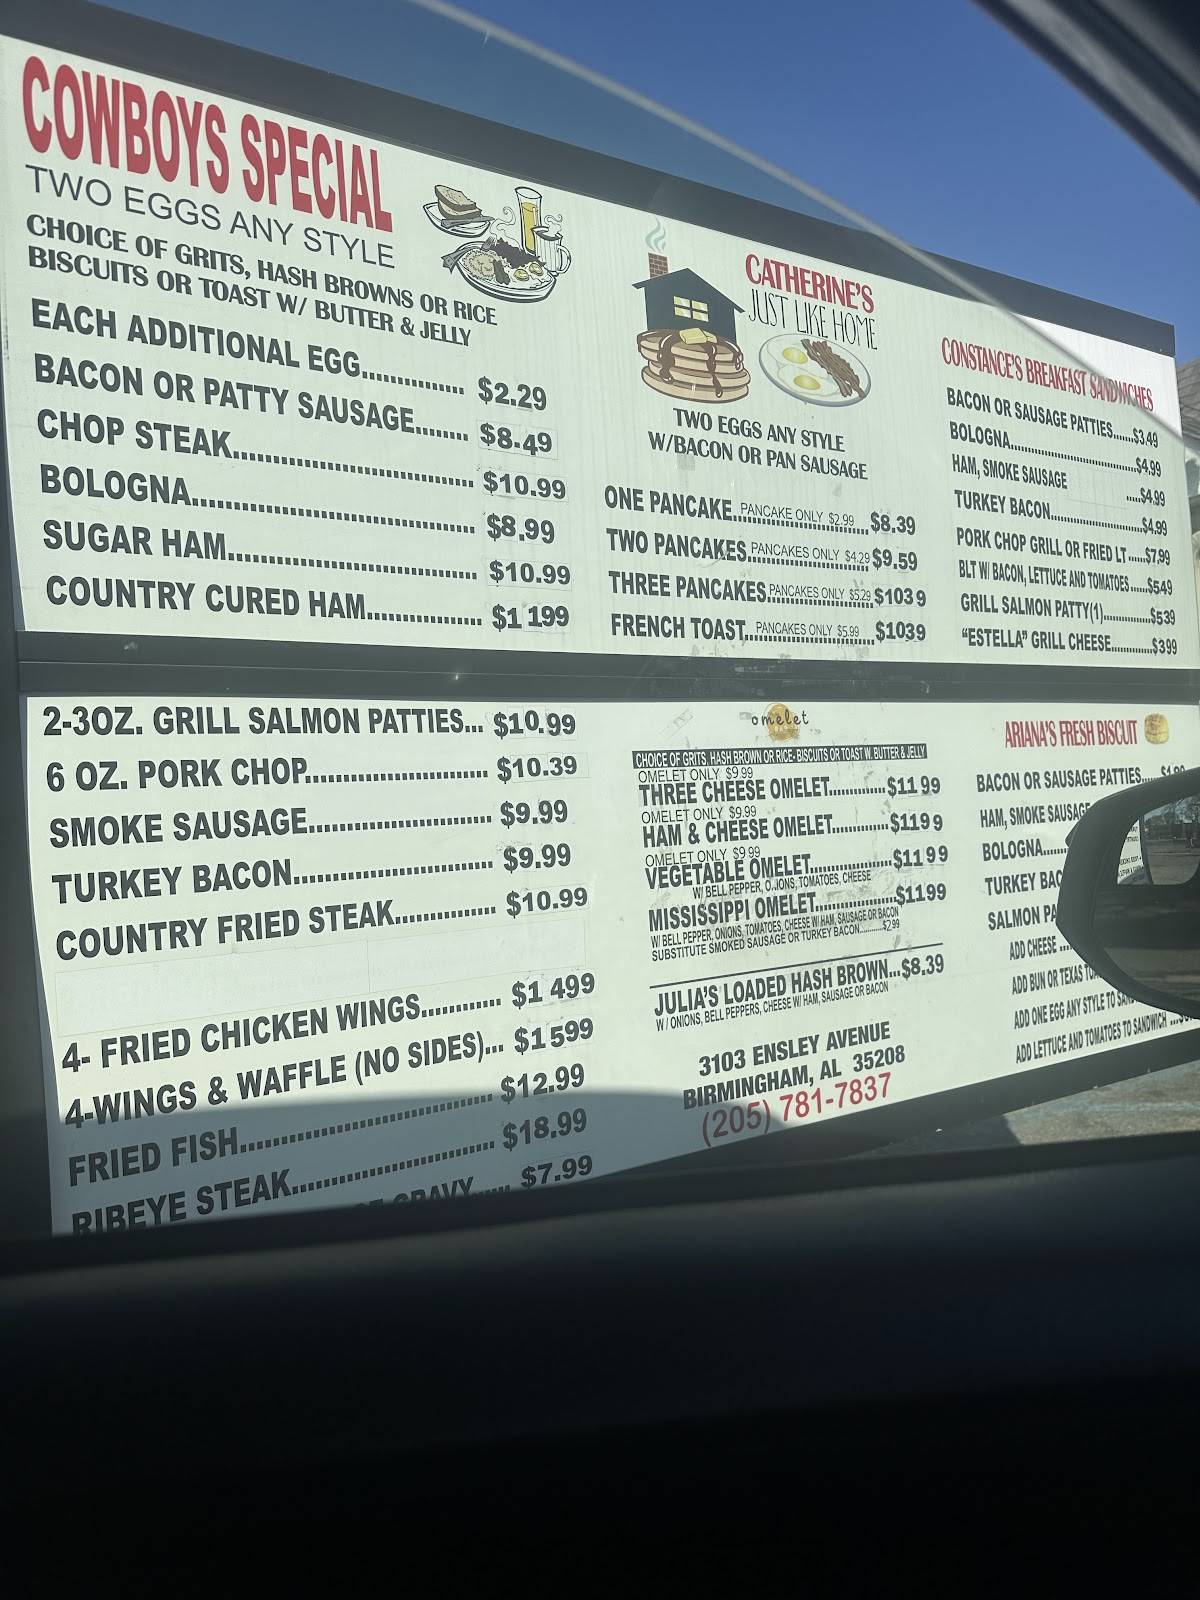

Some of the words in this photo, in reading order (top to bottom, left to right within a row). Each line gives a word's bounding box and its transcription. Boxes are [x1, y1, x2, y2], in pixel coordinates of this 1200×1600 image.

[22, 56, 230, 194] COWBOYS
[241, 113, 392, 232] SPECIAL
[26, 164, 112, 207] TWO
[124, 186, 221, 231] EGGS
[230, 211, 294, 246] ANY
[304, 227, 394, 268] STYLE
[27, 214, 128, 252] CHOICE
[136, 235, 168, 260] OF
[175, 245, 251, 279] GRITS,
[258, 260, 317, 289] HASH
[325, 273, 413, 308] BROWNS
[420, 293, 448, 316] OR
[454, 302, 497, 326] RICE
[29, 246, 149, 287] BISCUITS
[157, 270, 191, 296] OR
[198, 278, 270, 309] TOAST
[277, 292, 307, 316] W/
[316, 299, 394, 332] BUTTER
[400, 317, 415, 336] &
[420, 321, 471, 347] JELLY
[749, 289, 788, 328] JUST
[795, 300, 828, 338] LIKE
[833, 308, 877, 350] HOME
[31, 298, 117, 339] EACH
[128, 314, 300, 368] ADDITIONAL
[478, 376, 547, 410] $2.29
[34, 353, 143, 396] BACON
[154, 371, 195, 403] OR
[204, 377, 289, 414] PATTY
[1026, 358, 1087, 395] BREAKFAST
[1090, 374, 1153, 411] SANDWICHES
[947, 387, 990, 413] BACON
[995, 398, 1012, 418] OR
[1015, 404, 1067, 429] SAUSAGE
[673, 408, 712, 431] TWO
[718, 416, 762, 439] EGGS
[767, 424, 796, 445] ANY
[801, 430, 845, 452] STYLE
[38, 409, 124, 445] CHOP
[483, 471, 566, 499] $10.99
[739, 445, 761, 465] OR
[767, 450, 796, 470] PAN
[801, 455, 868, 480] SAUSAGE
[952, 454, 980, 479] HAM,
[983, 459, 1019, 481] SMOKE
[1022, 467, 1067, 489] SAUSAGE
[604, 485, 643, 512] ONE
[741, 503, 793, 520] PANCAKE
[796, 509, 823, 522] ONLY
[954, 490, 1005, 514] TURKEY
[487, 513, 554, 544] $8.99
[606, 528, 648, 553] TWO
[751, 542, 810, 559] PANCAKES
[813, 548, 839, 561] ONLY
[957, 527, 991, 548] PORK
[995, 532, 1026, 552] CHOP
[1030, 537, 1062, 556] GRILL
[1066, 540, 1080, 558] OR
[1083, 543, 1112, 562] FRIED
[44, 519, 153, 555] SUGAR
[489, 560, 571, 585] $10.99
[609, 571, 670, 596] THREE
[769, 584, 819, 598] PANCAKES
[822, 588, 844, 600] ONLY
[959, 560, 976, 579] BLT
[1029, 566, 1066, 587] LETTUCE
[1069, 571, 1085, 588] AND
[1088, 573, 1129, 592] TOMATOES
[46, 575, 195, 610] COUNTRY
[206, 584, 299, 616] CURED
[961, 593, 998, 613] GRILL
[1002, 596, 1051, 616] SALMON
[611, 614, 685, 638] FRENCH
[756, 621, 806, 635] PANCAKES
[810, 625, 832, 636] ONLY
[1032, 631, 1065, 650] GRILL
[153, 706, 240, 735] GRILL
[249, 706, 359, 734] SALMON
[751, 710, 809, 726] omelet
[1059, 720, 1094, 746] FRESH
[1097, 720, 1137, 745] BISCUIT
[636, 752, 668, 767] CHOICE
[734, 750, 760, 764] BROWN
[764, 750, 774, 763] OR
[797, 748, 828, 761] BISCUITS
[46, 762, 64, 792] 6
[138, 759, 222, 788] PORK
[638, 769, 686, 783] OMELET
[690, 768, 720, 780] ONLY
[639, 782, 697, 806] THREE
[702, 779, 765, 803] CHEESE
[977, 772, 1020, 792] BACON
[1024, 771, 1041, 789] OR
[1045, 769, 1096, 788] SAUSAGE
[50, 814, 163, 848] SMOKE
[641, 810, 690, 823] OMELET
[693, 808, 723, 821] ONLY
[1010, 806, 1045, 826] SMOKE
[643, 824, 682, 848] HAM
[688, 823, 700, 844] &
[705, 818, 768, 842] CHEESE
[52, 866, 182, 904] TURKEY
[503, 843, 571, 874] $9.99
[645, 859, 744, 890] VEGETABLE
[985, 873, 1036, 896] TURKEY
[706, 885, 727, 898] BELL
[56, 918, 207, 961] COUNTRY
[217, 909, 300, 944] FRIED
[506, 887, 588, 919] $10.99
[649, 898, 750, 931] MISSISSIPPI
[988, 907, 1040, 930] SALMON
[652, 944, 706, 961] SUBSTITUTE
[709, 940, 744, 953] SMOKED
[748, 934, 786, 948] SAUSAGE
[1010, 941, 1025, 960] ADD
[1027, 936, 1057, 957] CHEESE
[724, 975, 787, 1005] LOADED
[791, 967, 833, 993] HASH
[1012, 976, 1027, 995] ADD
[1030, 973, 1045, 991] BUN
[1048, 970, 1058, 987] OR
[1060, 965, 1083, 986] TEXAS
[704, 1008, 724, 1024] BELL
[763, 997, 791, 1014] CHEESE
[1014, 1010, 1029, 1029] ADD
[1032, 1006, 1047, 1025] ONE
[1050, 1002, 1065, 1022] EGG
[1067, 999, 1082, 1018] ANY
[1083, 995, 1104, 1014] STYLE
[101, 1027, 191, 1068] FRIED
[201, 1006, 328, 1052] CHICKEN
[699, 1049, 745, 1076] 3103
[753, 1035, 819, 1066] ENSLEY
[827, 1021, 890, 1050] AVENUE
[1016, 1044, 1031, 1063] ADD
[1034, 1036, 1066, 1059] LETTUCE
[1069, 1032, 1083, 1051] AND
[1085, 1022, 1121, 1047] TOMATOES
[1133, 1012, 1167, 1035] SANDWICH
[207, 1076, 228, 1106] &
[237, 1055, 346, 1100] WAFFLE
[356, 1046, 399, 1086] (NO
[683, 1065, 814, 1110] BIRMINGHAM,
[820, 1059, 841, 1080] AL
[853, 1045, 905, 1072] 35208
[68, 1142, 161, 1187] FRIED
[500, 1063, 584, 1104] $12.99
[702, 1100, 770, 1147] (205)
[780, 1072, 891, 1121] 781-7837
[502, 1108, 586, 1151] $18.99
